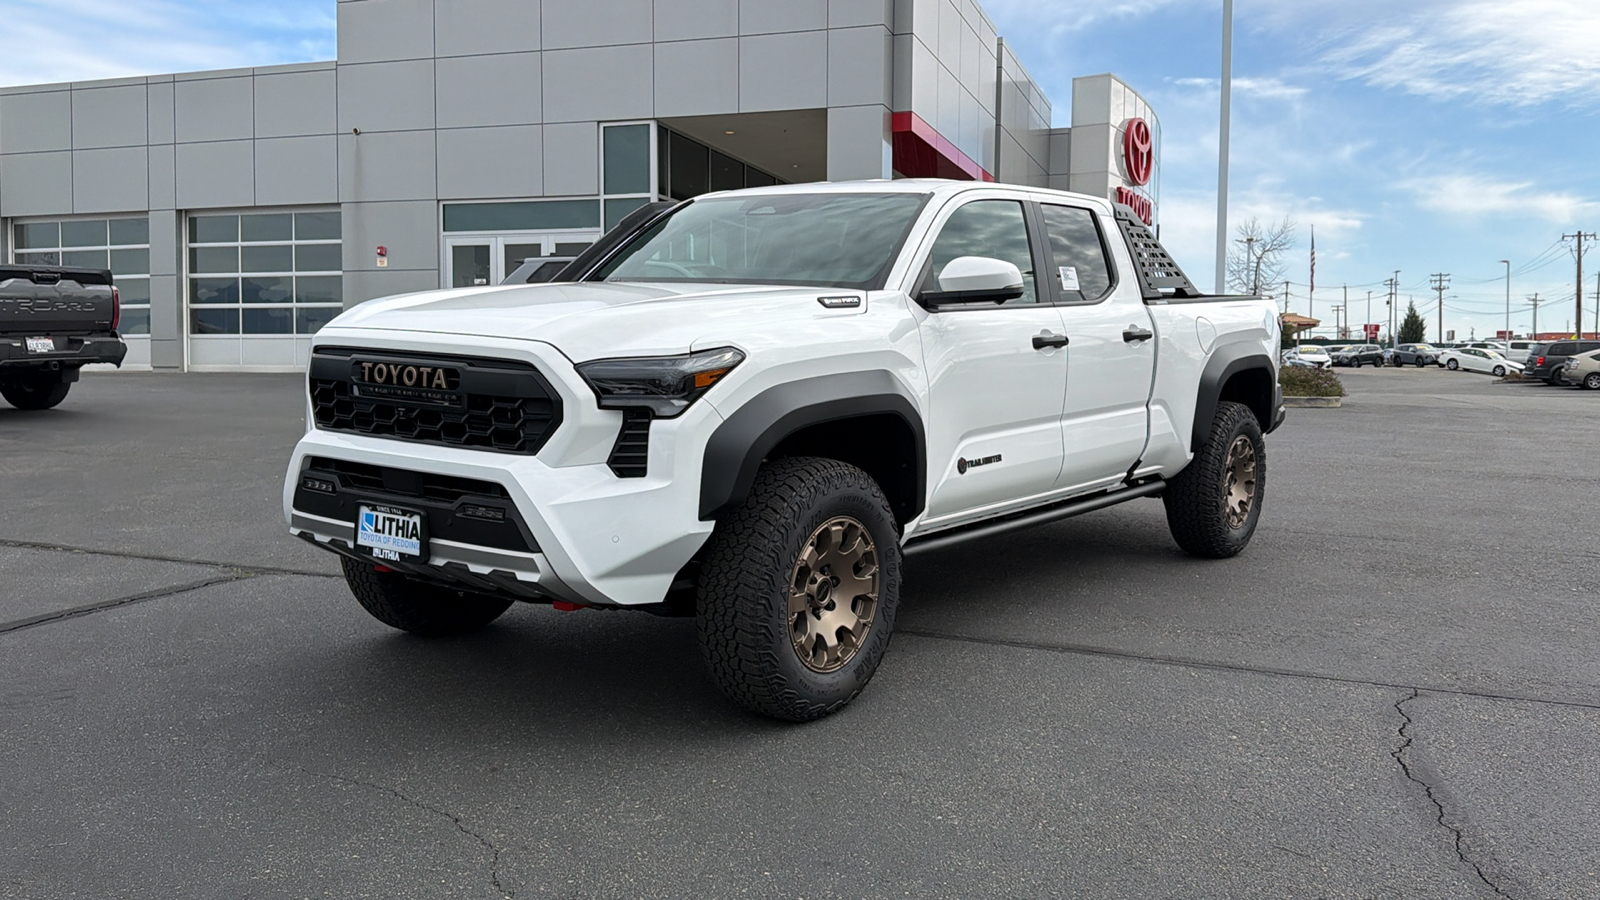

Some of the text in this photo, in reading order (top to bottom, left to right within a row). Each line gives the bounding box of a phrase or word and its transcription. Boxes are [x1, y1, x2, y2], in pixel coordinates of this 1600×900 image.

[1116, 187, 1152, 226] TOYOTA
[53, 302, 96, 311] PRO
[361, 362, 447, 389] TOYOTA
[376, 505, 391, 514] SINCE
[374, 514, 420, 540] LITHIA
[360, 531, 420, 550] TOYOTA OF REDDING
[378, 548, 401, 562] LITHIA
